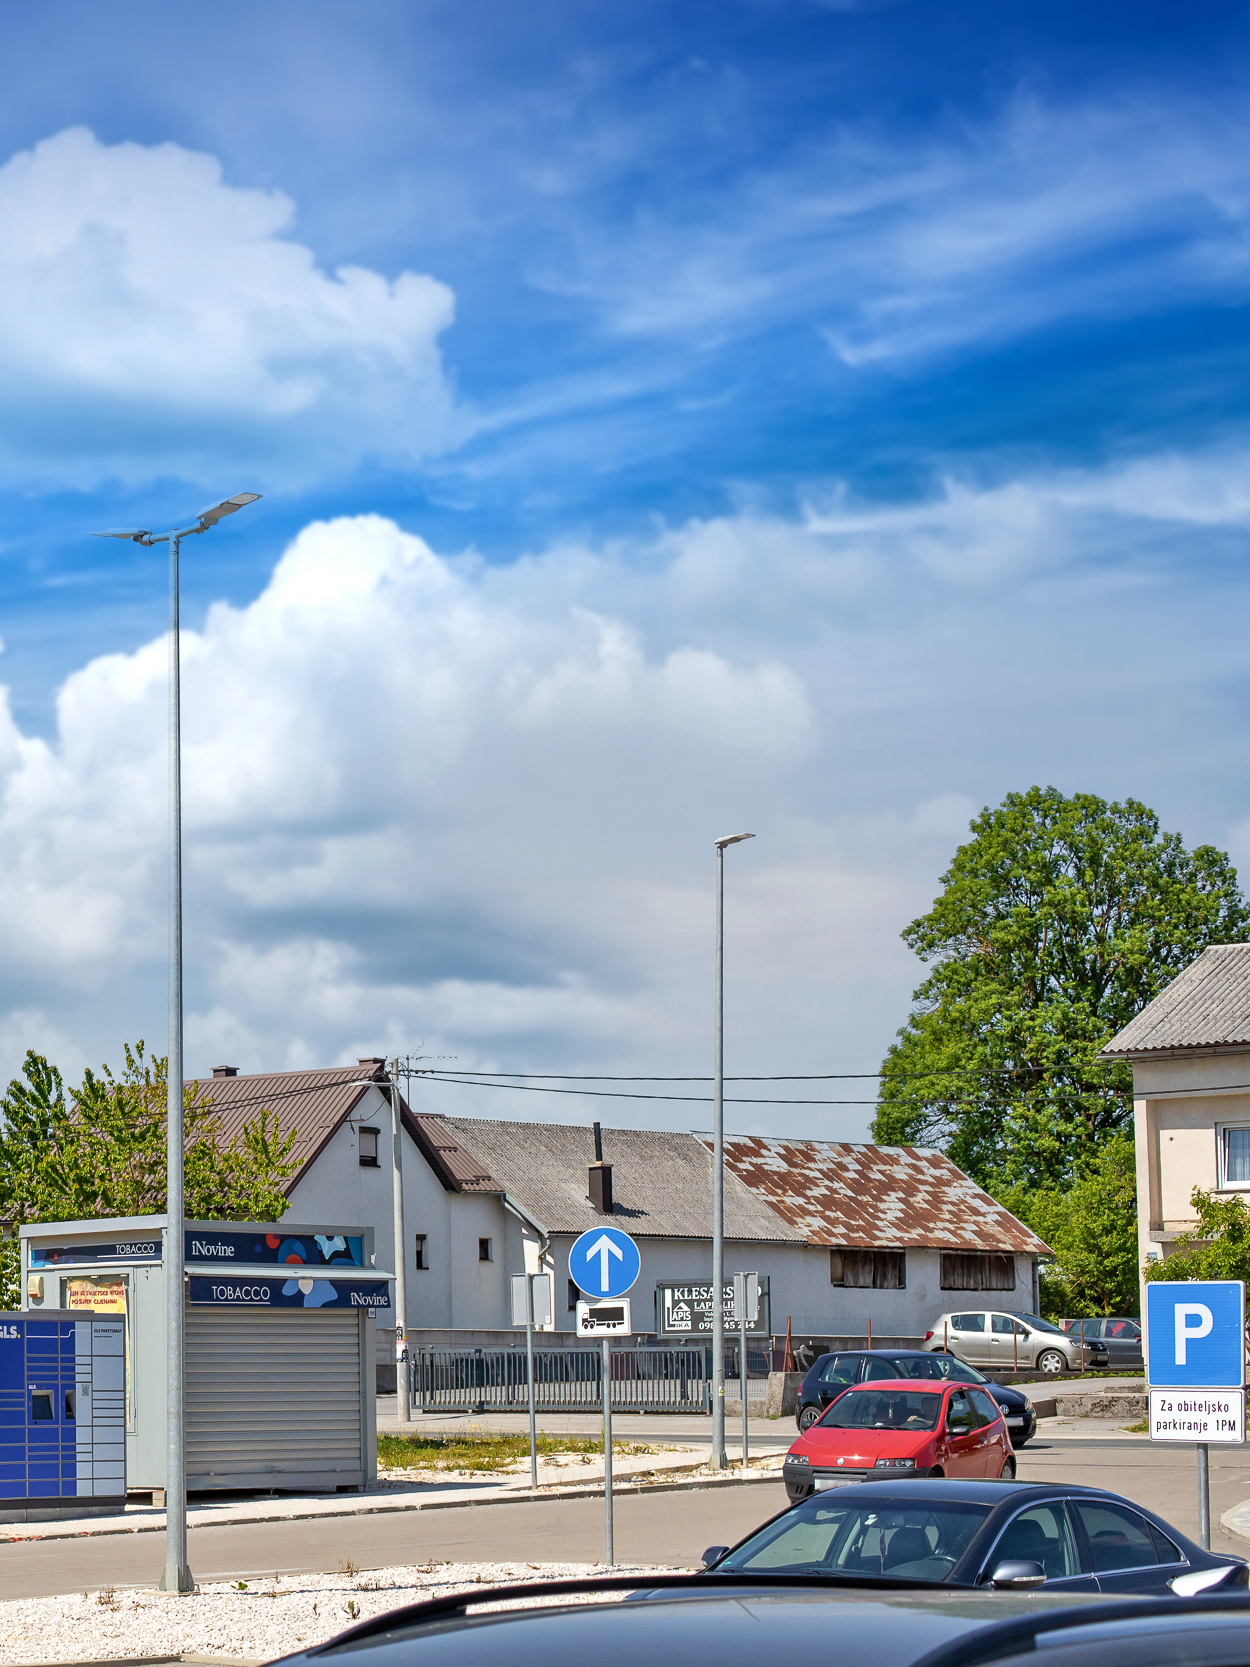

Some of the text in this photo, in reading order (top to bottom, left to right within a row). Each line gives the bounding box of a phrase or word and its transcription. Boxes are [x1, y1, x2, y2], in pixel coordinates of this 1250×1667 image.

[115, 1243, 155, 1255] TOBACCO
[191, 1240, 235, 1257] iNovine
[212, 1285, 271, 1301] TOBACCO
[350, 1292, 388, 1306] iNovine
[1174, 1303, 1214, 1365] P
[1161, 1399, 1230, 1415] Za obiteljsko
[1156, 1418, 1236, 1434] parkiranje 1PM
